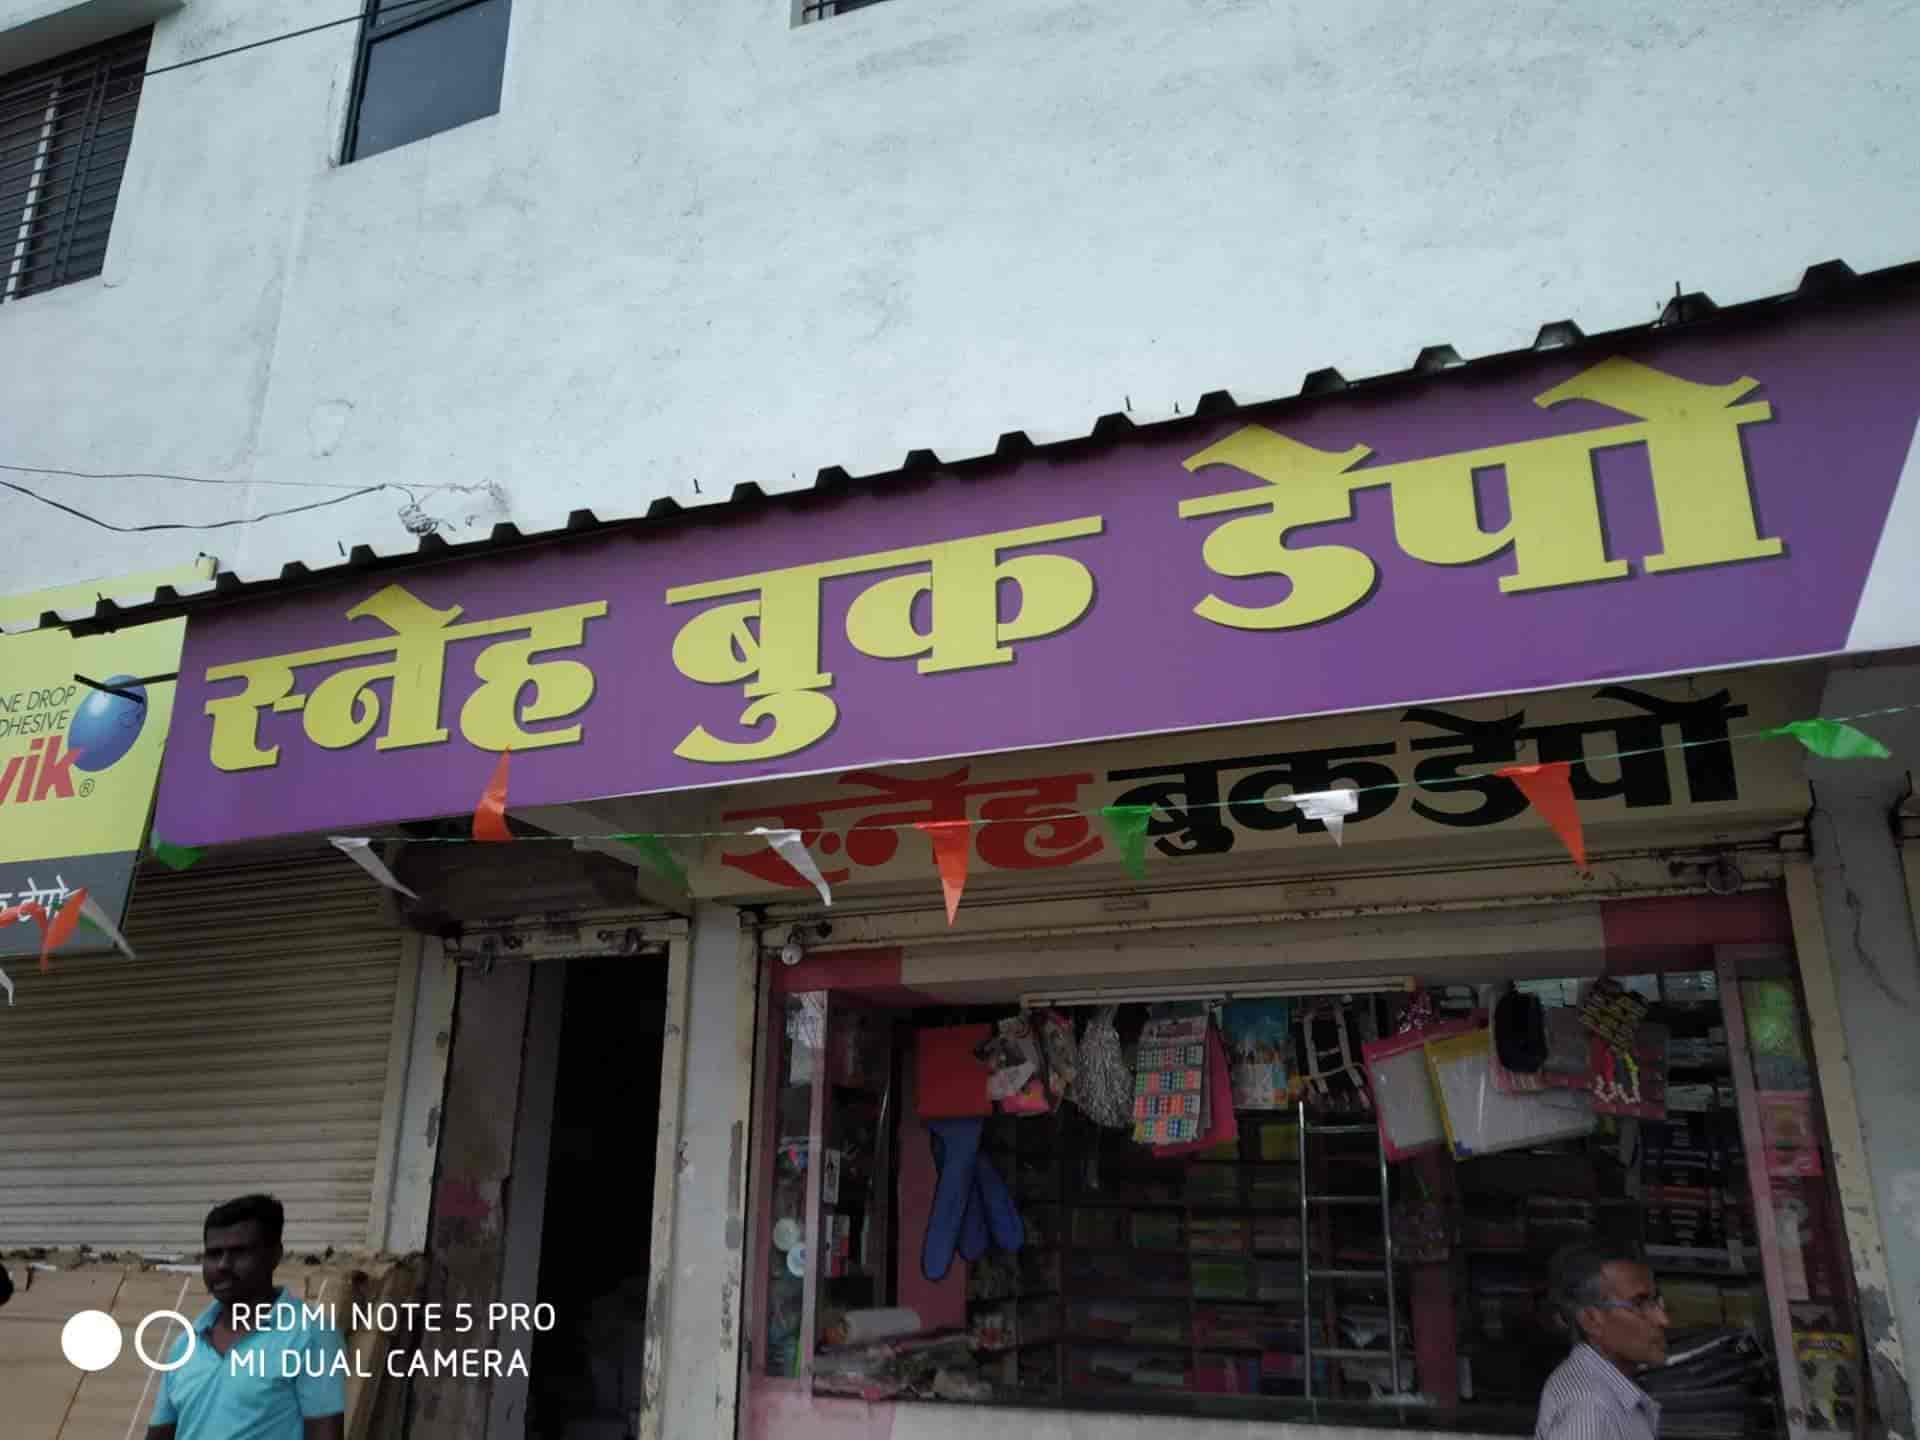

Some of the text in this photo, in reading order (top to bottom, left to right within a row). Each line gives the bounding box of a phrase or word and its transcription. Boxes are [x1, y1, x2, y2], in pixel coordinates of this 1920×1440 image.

[205, 356, 1783, 771] स्नेह बुक डेपो
[27, 686, 76, 710] DROP
